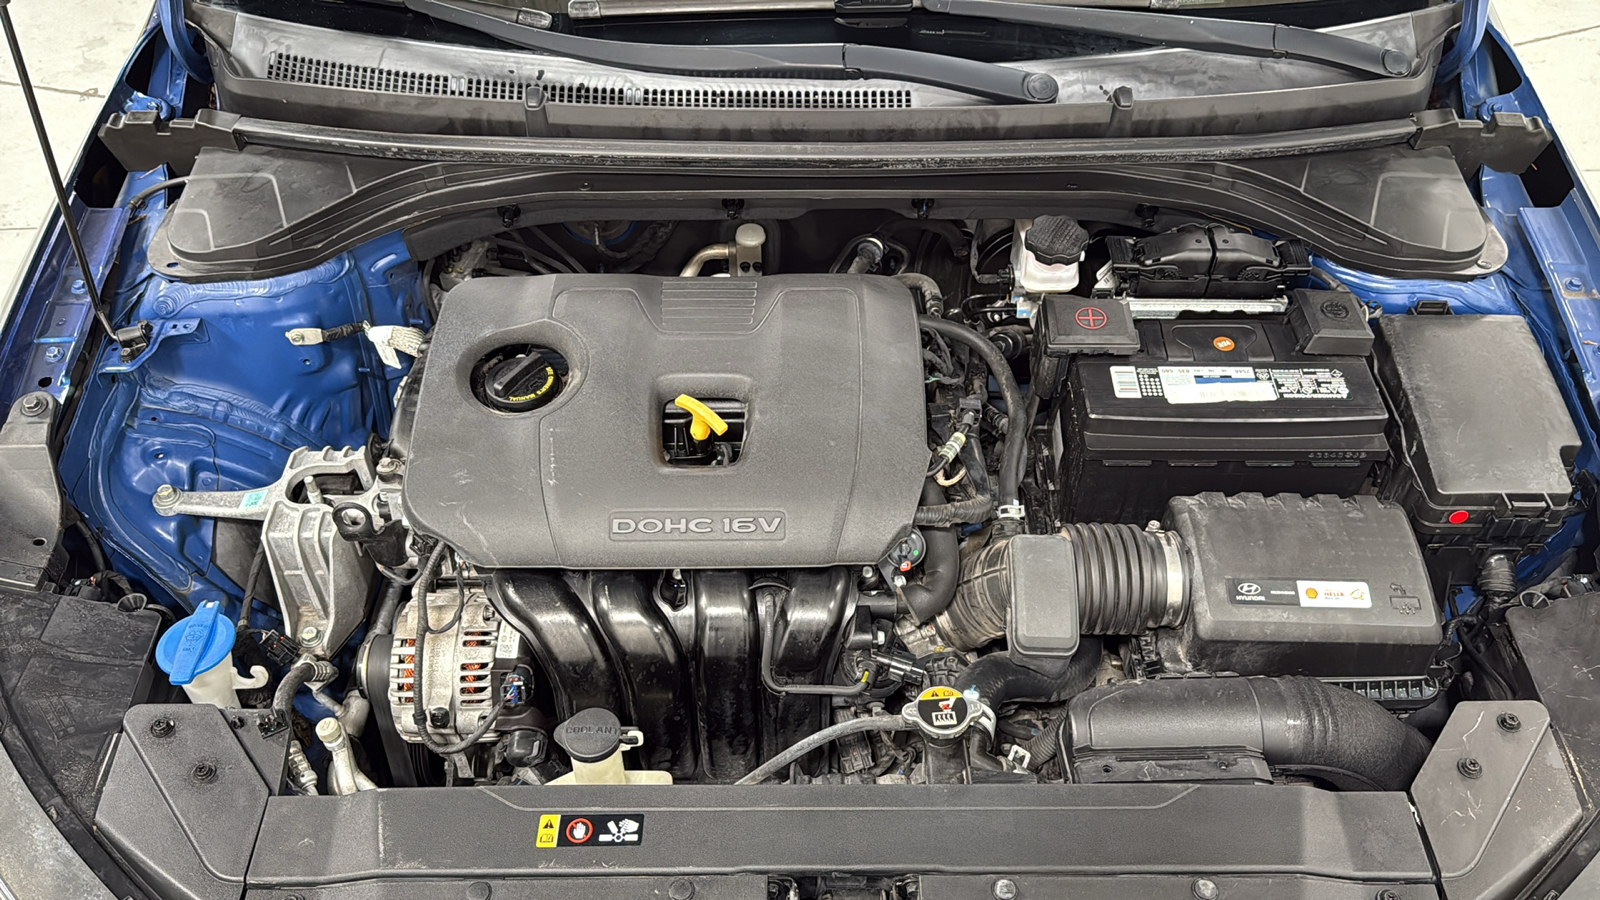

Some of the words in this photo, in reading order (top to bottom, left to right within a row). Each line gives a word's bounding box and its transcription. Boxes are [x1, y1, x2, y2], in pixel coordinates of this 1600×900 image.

[509, 393, 536, 402] MANUAL
[612, 518, 713, 534] DOHC
[722, 517, 782, 533] 16V
[565, 725, 620, 735] COOLANT
